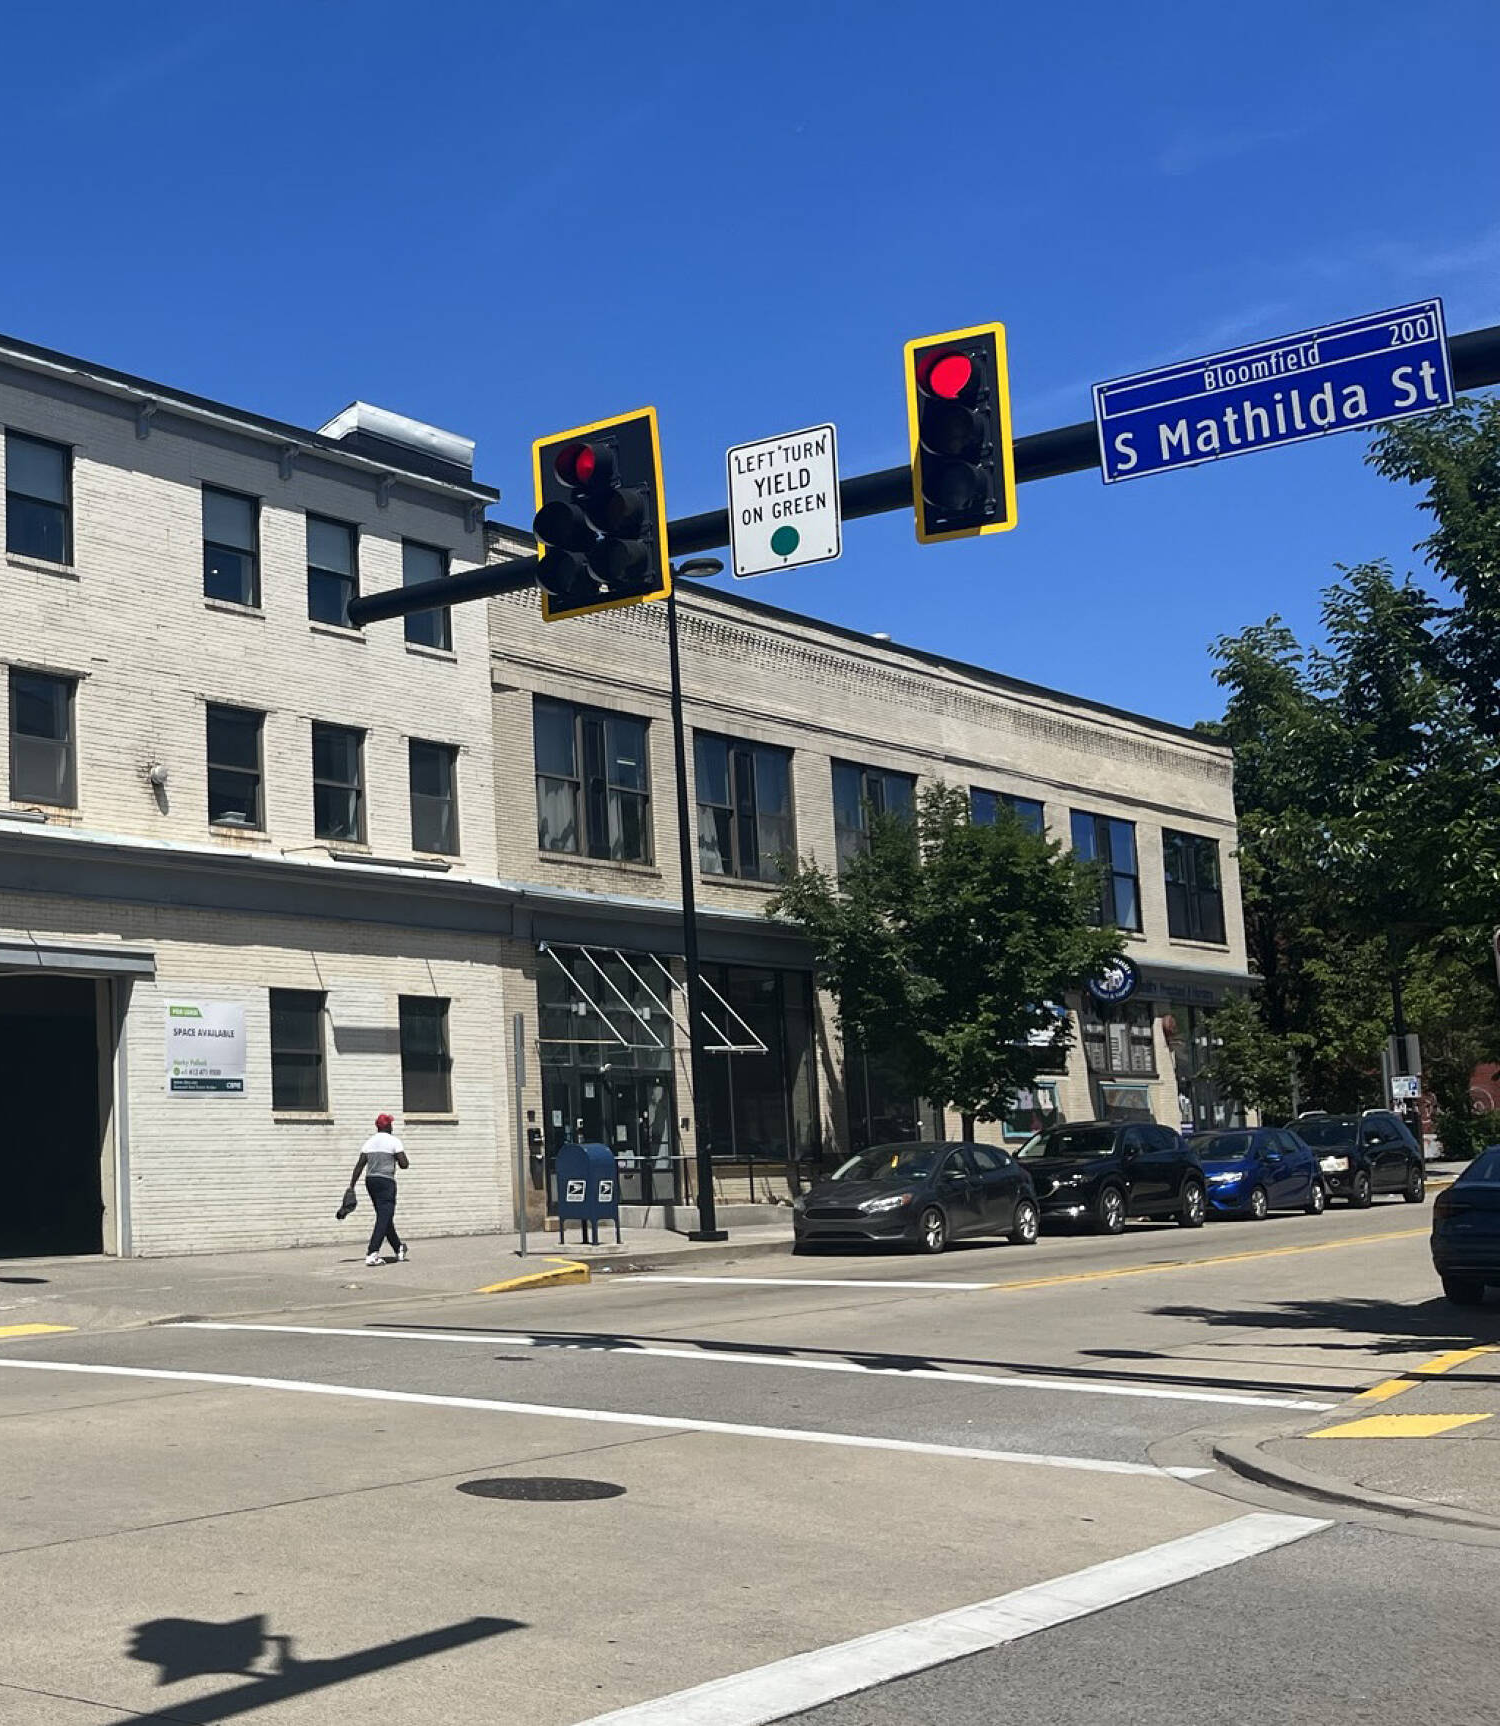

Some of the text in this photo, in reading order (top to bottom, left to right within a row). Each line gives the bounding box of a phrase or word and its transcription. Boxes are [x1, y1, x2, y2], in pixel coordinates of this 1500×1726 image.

[1203, 317, 1429, 391] Bloomfield 200
[1114, 361, 1439, 470] S Mathilda St
[738, 440, 826, 474] LEFT TURN
[754, 469, 811, 497] YIELD
[742, 492, 826, 525] ON GREEN
[173, 1028, 235, 1038] SPACE AVAILABLE
